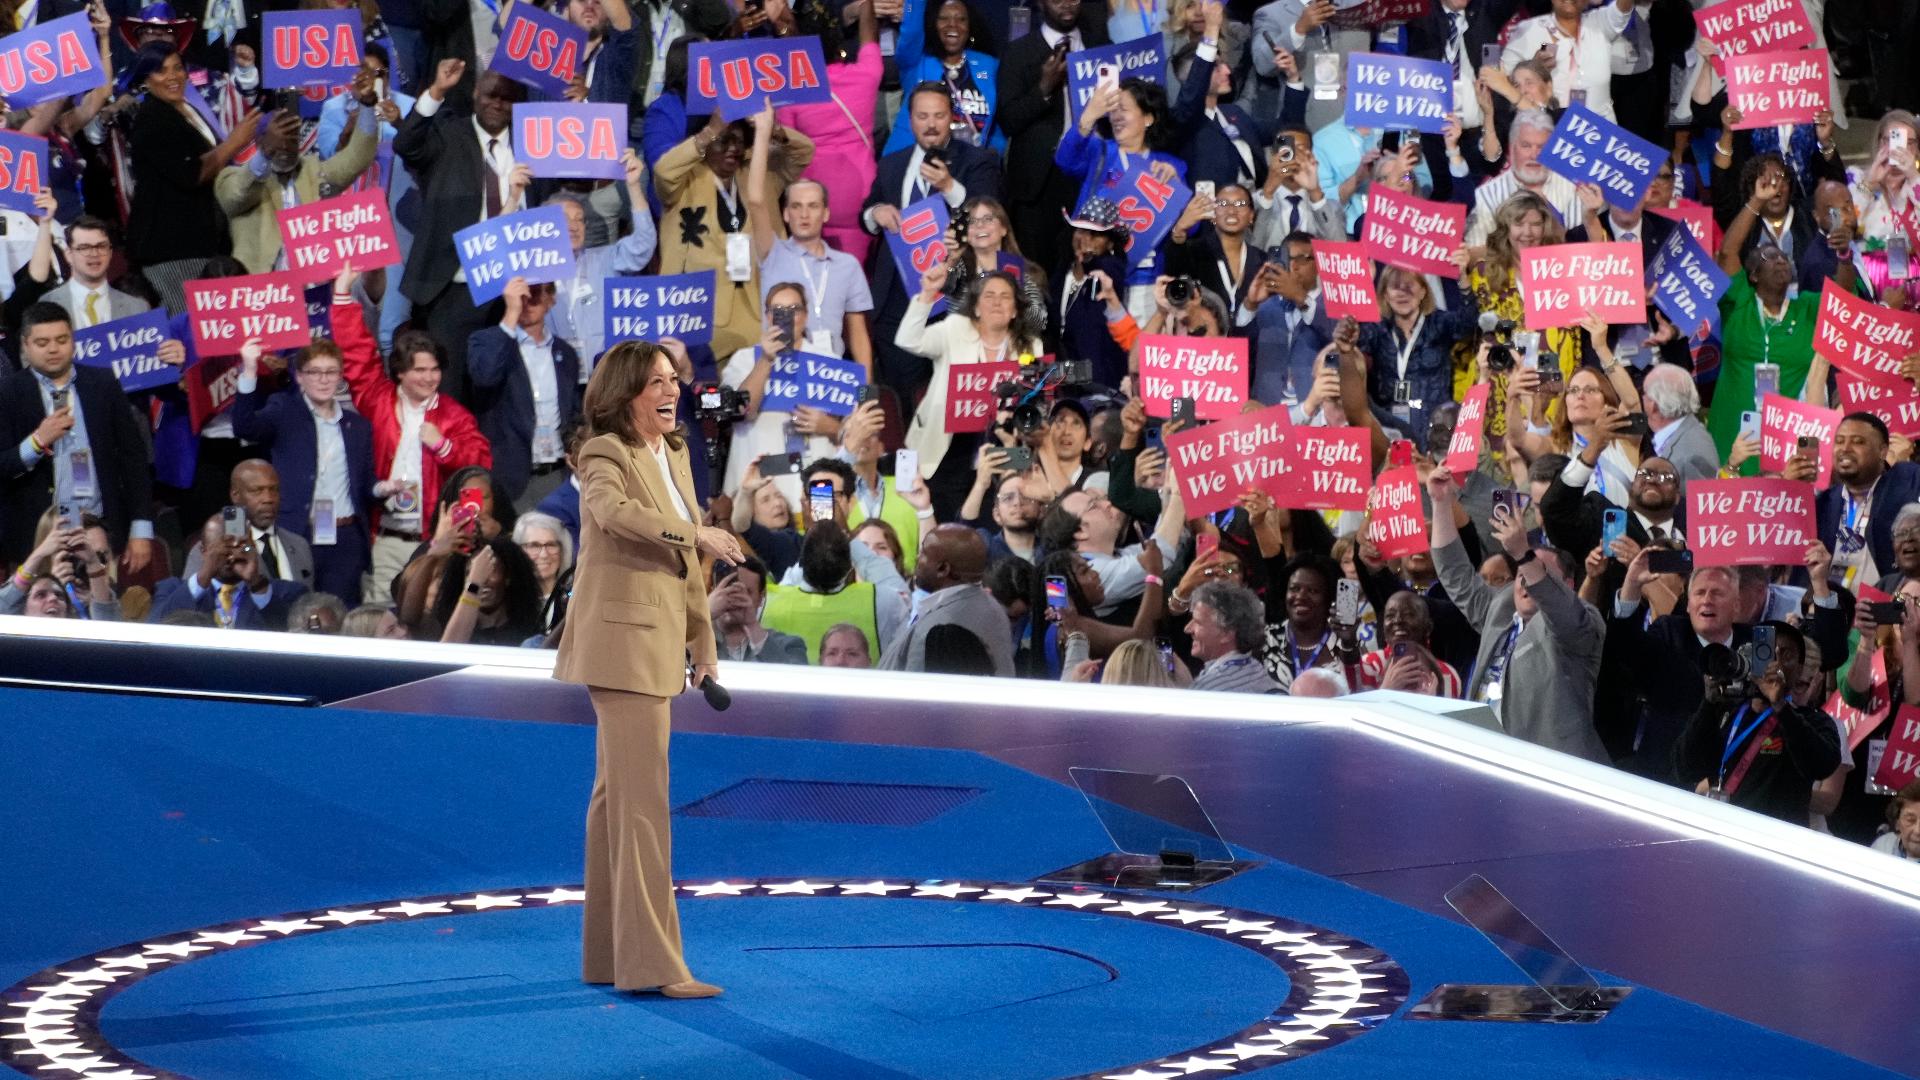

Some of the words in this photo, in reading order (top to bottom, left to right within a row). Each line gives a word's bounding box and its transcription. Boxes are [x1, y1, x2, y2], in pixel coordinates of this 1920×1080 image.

[1703, 14, 1734, 38] We
[1736, 0, 1793, 23] Fight,
[273, 24, 360, 69] USA
[506, 17, 578, 82] USA
[1716, 37, 1748, 61] We
[1750, 20, 1803, 47] Win.
[0, 30, 92, 94] USA
[722, 50, 820, 100] USA
[1115, 49, 1159, 73] Vote,
[1734, 65, 1765, 85] We
[1768, 60, 1823, 86] Fight,
[1356, 64, 1392, 86] We
[1397, 68, 1448, 94] Vote,
[1354, 93, 1390, 114] We
[1395, 95, 1449, 119] Win.
[1737, 92, 1771, 113] We
[1777, 88, 1824, 110] Win.
[524, 116, 618, 160] USA
[1566, 114, 1602, 145] We
[1604, 135, 1650, 175] Vote,
[0, 145, 40, 195] SA
[1552, 137, 1587, 168] We
[1588, 158, 1635, 198] Win.
[1119, 171, 1175, 233] SA
[1372, 194, 1400, 220] We
[1401, 205, 1457, 238] Fight,
[286, 216, 319, 240] We
[322, 203, 381, 232] Fight,
[1368, 222, 1397, 250] We
[294, 244, 330, 268] We
[334, 234, 389, 259] Win.
[463, 231, 498, 261] We
[502, 219, 561, 246] Vote,
[901, 208, 948, 273] US
[471, 260, 504, 288] We
[508, 247, 567, 272] Win.
[1317, 252, 1331, 272] We
[1330, 252, 1366, 279] Fight,
[1530, 258, 1565, 280] We
[1566, 254, 1634, 279] Fight,
[1668, 230, 1683, 258] We
[1679, 251, 1715, 299] Vote,
[194, 290, 227, 311] We
[229, 284, 295, 311] Fight,
[612, 287, 650, 308] We
[656, 285, 709, 307] Vote,
[1323, 281, 1340, 303] We
[1339, 281, 1372, 306] Win.
[1533, 289, 1570, 311] We
[1577, 286, 1637, 309] Win.
[1660, 272, 1697, 320] Win.
[200, 318, 235, 341] We
[241, 313, 300, 337] Win.
[612, 316, 649, 337] We
[657, 314, 708, 335] Win.
[1826, 292, 1852, 323] We
[1852, 311, 1914, 349] Fight,
[107, 326, 164, 351] Vote,
[1821, 319, 1848, 352] We
[1852, 342, 1902, 375] Win
[112, 354, 169, 379] Win.
[806, 360, 860, 386] Vote,
[1144, 345, 1170, 368] We
[1173, 348, 1240, 377] Fight,
[765, 378, 799, 399] We
[956, 372, 988, 392] We
[1145, 377, 1174, 400] We
[1181, 380, 1240, 403] Win.
[1848, 381, 1881, 404] We
[954, 399, 989, 418] We
[1765, 405, 1784, 430] We
[1783, 411, 1831, 444] Fight,
[1177, 440, 1213, 468] We
[1218, 421, 1285, 456] Fight,
[1303, 438, 1363, 466] Fight,
[1764, 435, 1781, 460] We
[1187, 470, 1227, 499] We
[1232, 455, 1292, 487] Win.
[1312, 470, 1364, 494] Win.
[1382, 480, 1417, 510] Fight,
[1697, 492, 1733, 516] We
[1736, 490, 1808, 518] Fight,
[1368, 520, 1387, 543] We
[1389, 514, 1422, 539] Win.
[1698, 525, 1738, 548] We
[1747, 523, 1810, 547] Win.
